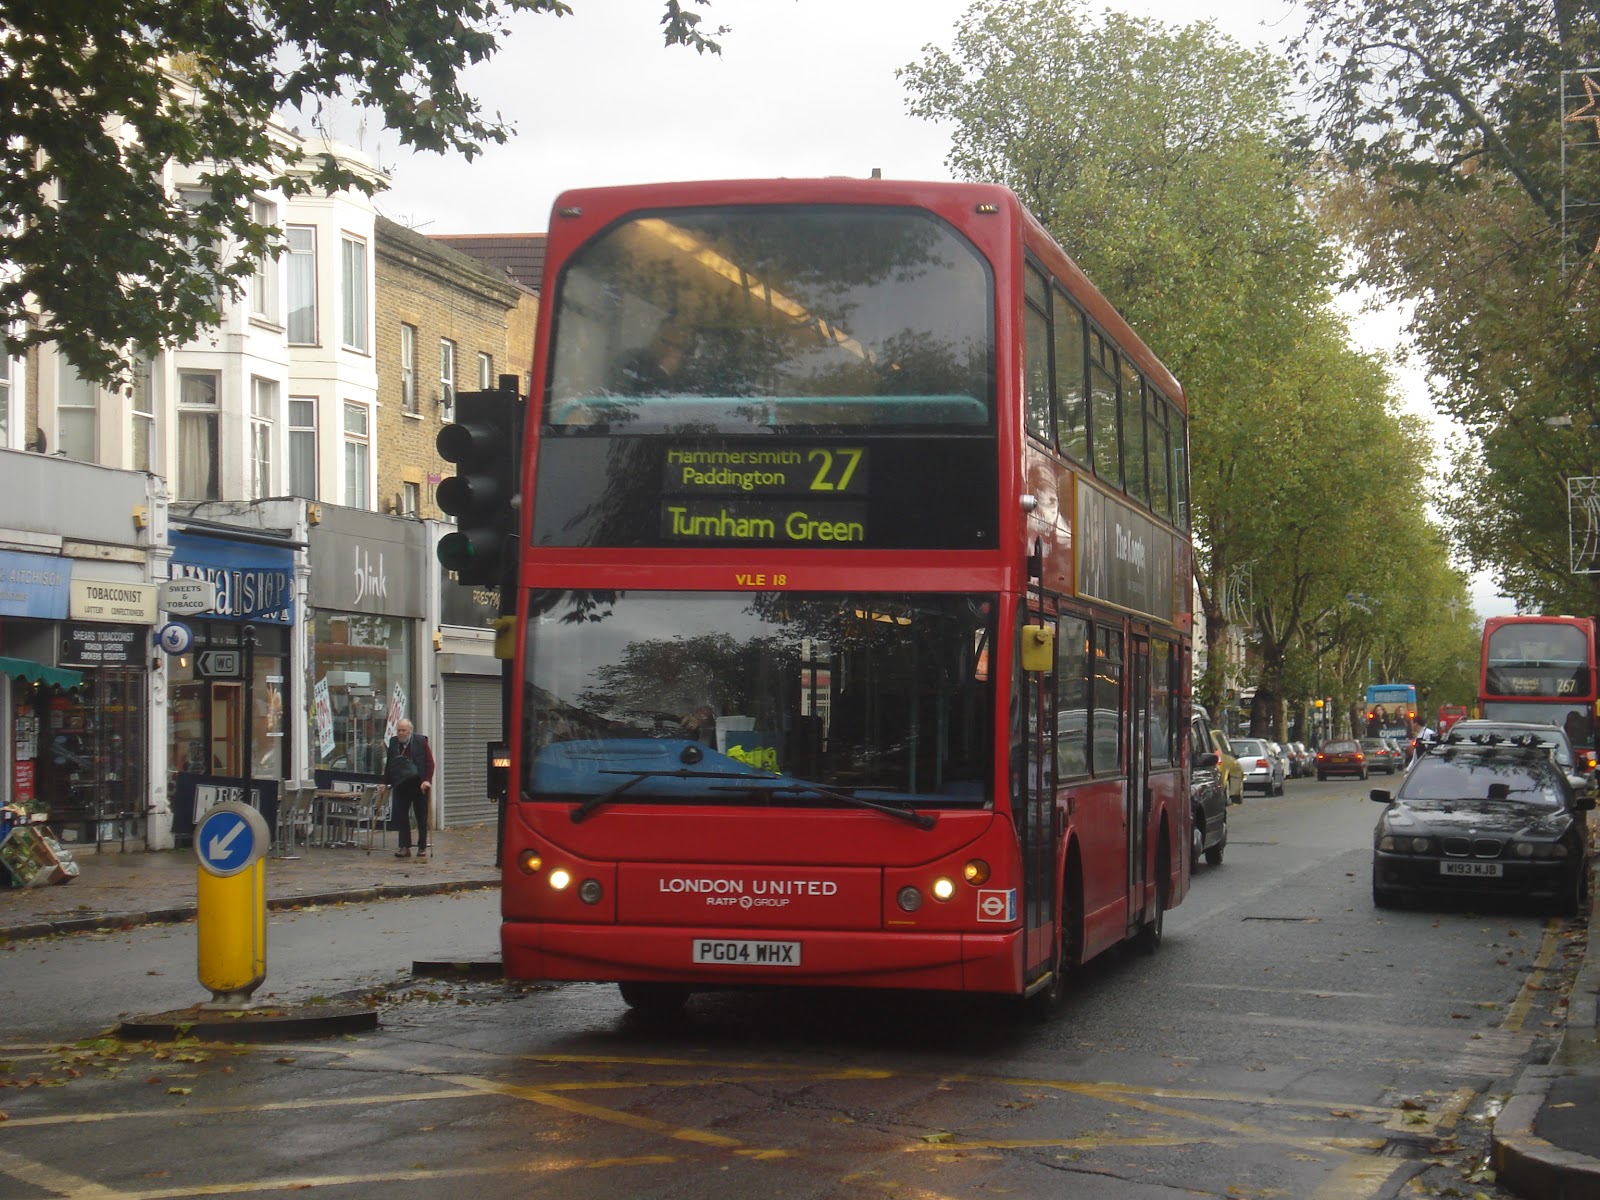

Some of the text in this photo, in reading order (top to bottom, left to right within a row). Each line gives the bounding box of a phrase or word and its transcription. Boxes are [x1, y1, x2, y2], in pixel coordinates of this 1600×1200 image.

[808, 449, 864, 491] 27
[682, 467, 786, 491] Paddington
[668, 507, 864, 541] Turnham Green
[354, 544, 387, 605] blink
[735, 574, 787, 586] VLE 18
[86, 586, 142, 603] TOBACCONIST
[169, 585, 202, 593] SWEETS
[243, 572, 286, 614] SHOP
[84, 605, 144, 617] LOTTERY CONFECTIONERS
[73, 630, 134, 642] SHEARS TOBACCONIST
[216, 657, 233, 670] WC
[1557, 679, 1577, 693] 267
[1379, 729, 1407, 738] Opens
[1446, 863, 1497, 875] W193 MJB
[659, 878, 838, 896] LONDON UNITED
[706, 897, 790, 907] RATP GROUP
[700, 942, 793, 963] PG04 WHX
